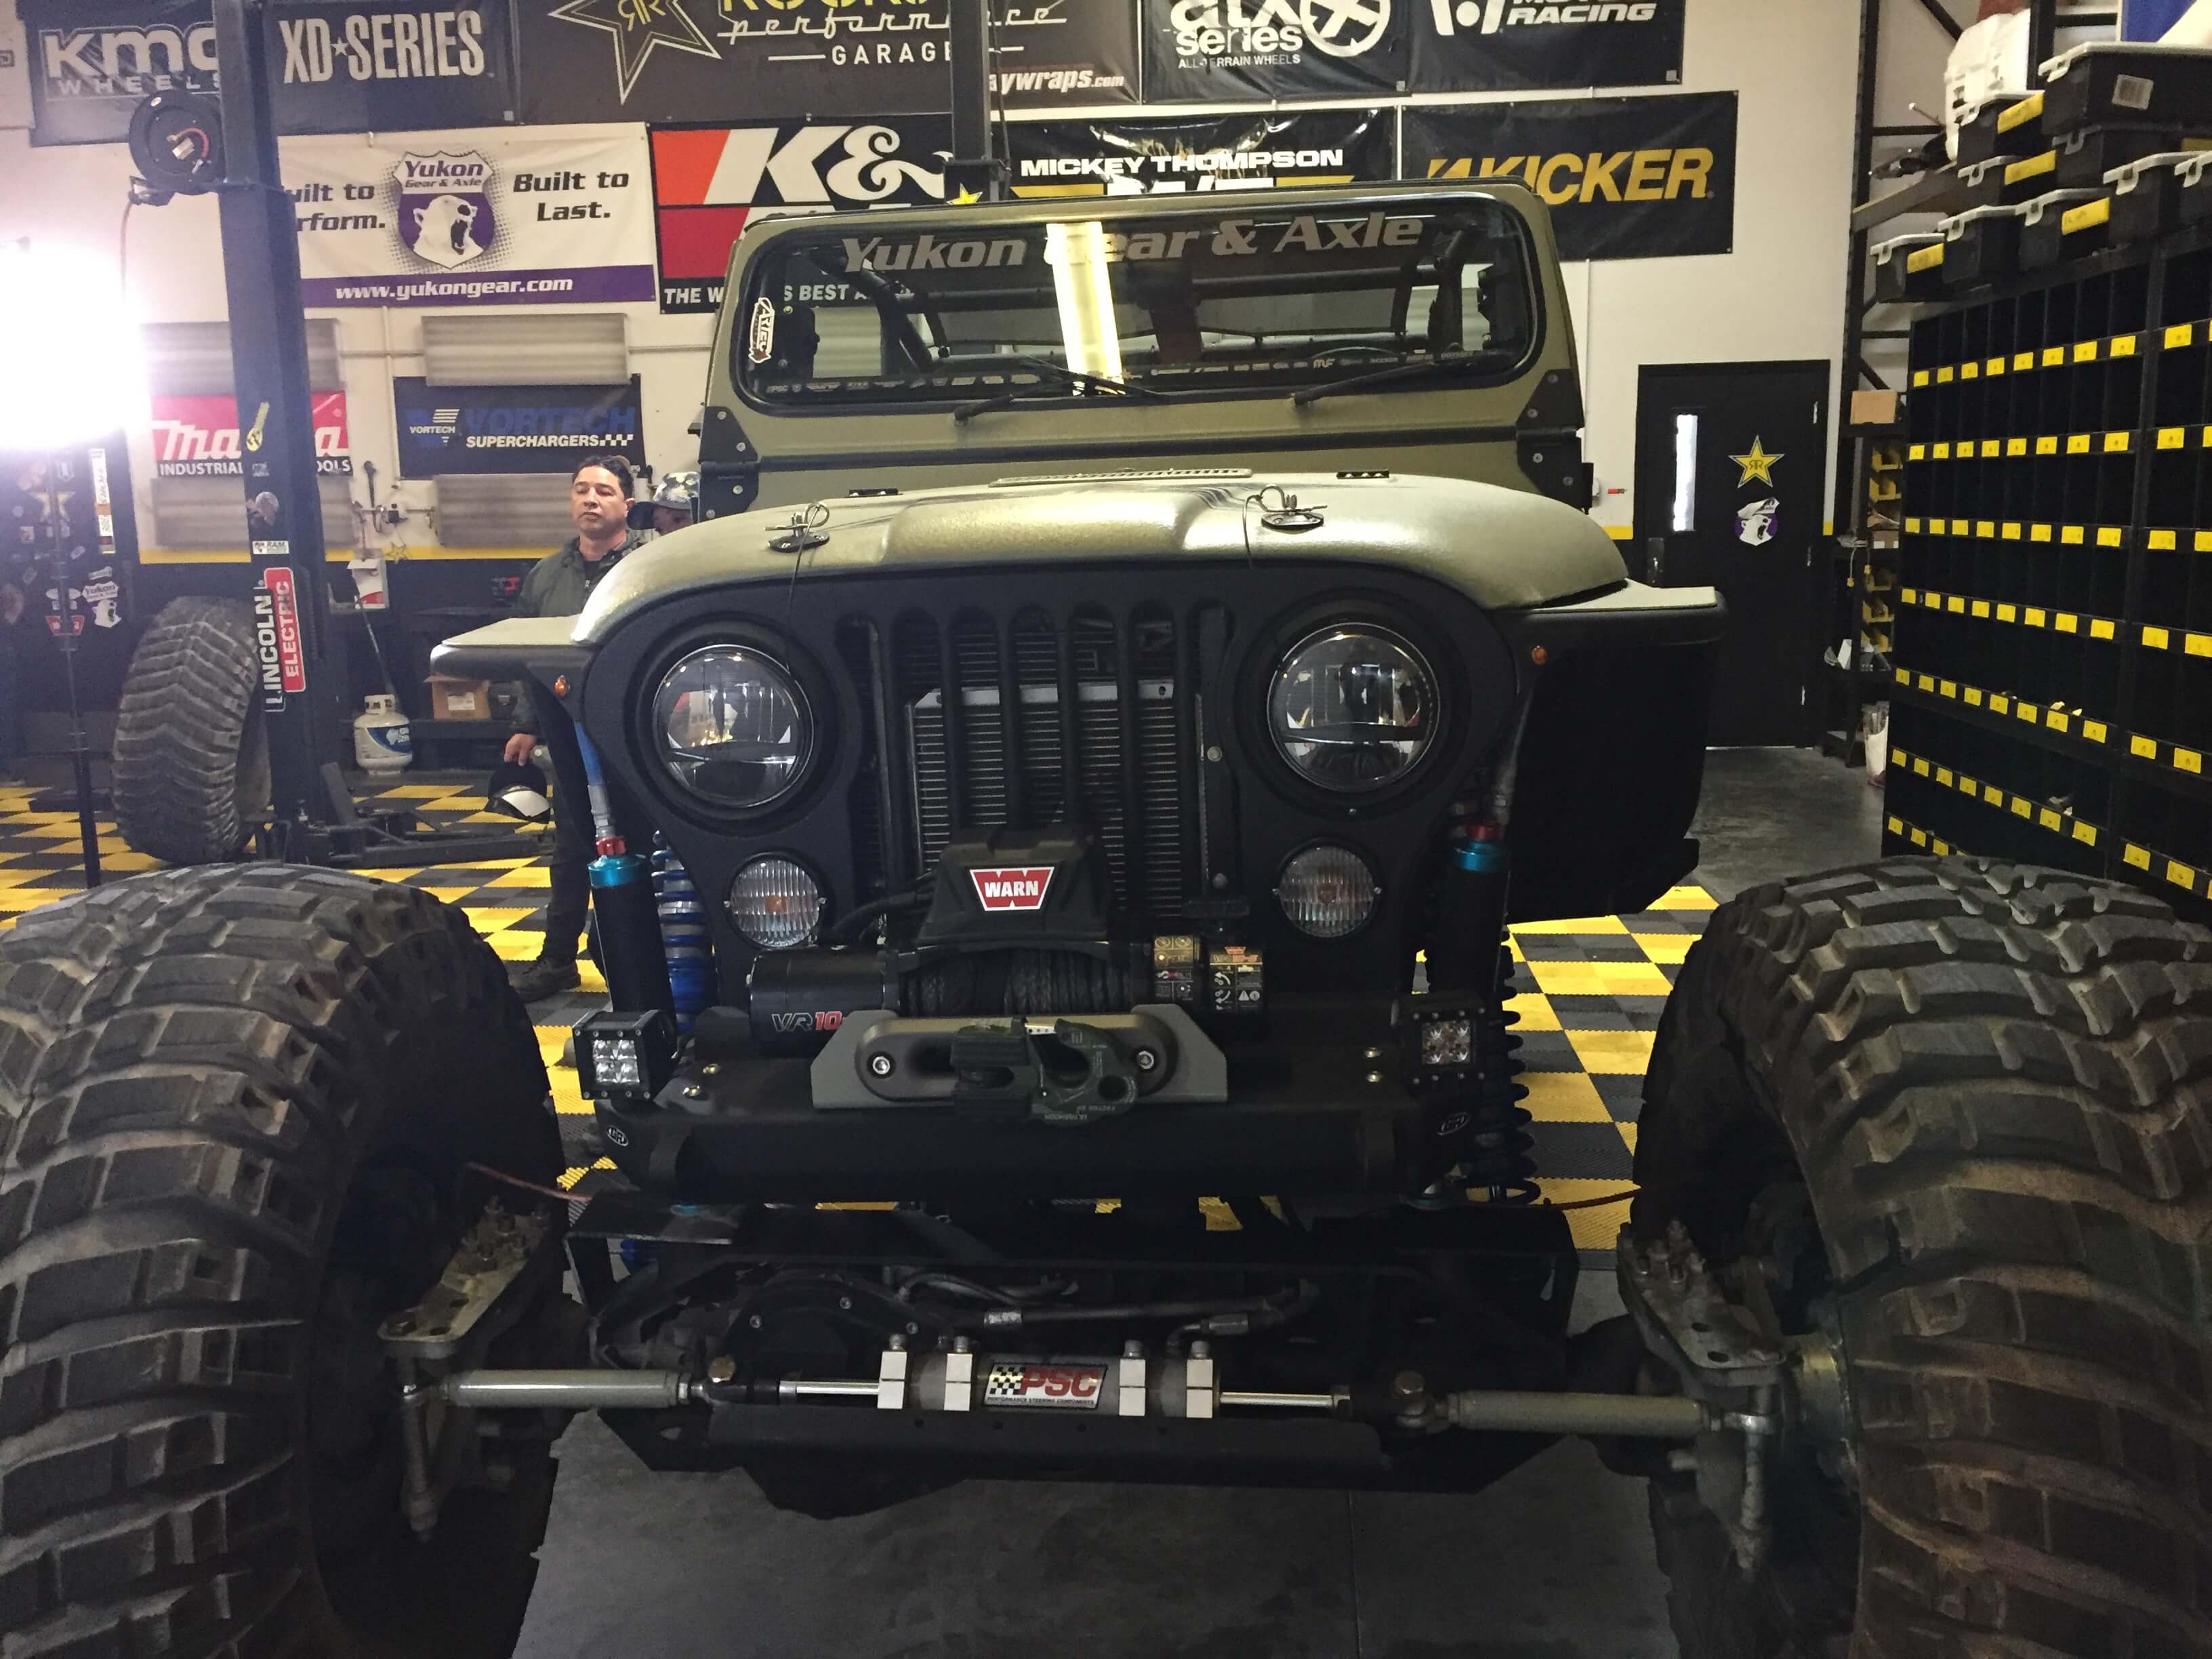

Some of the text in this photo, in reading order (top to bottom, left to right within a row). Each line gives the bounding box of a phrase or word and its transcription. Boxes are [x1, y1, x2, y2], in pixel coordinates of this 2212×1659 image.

[1507, 3, 1656, 25] RACING
[345, 10, 485, 81] SERIES
[1176, 26, 1303, 56] series
[1254, 54, 1301, 65] WHEELS
[405, 160, 483, 177] Yukon
[1021, 149, 1343, 177] MICKEY THOMPSON
[344, 184, 374, 200] to
[513, 171, 630, 192] Built to
[537, 201, 611, 222] Last.
[841, 234, 1027, 272] Yukon
[1211, 219, 1258, 255] &
[1273, 211, 1423, 253] Axle
[335, 279, 573, 300] www.yukongear.com
[663, 287, 701, 304] THE
[799, 284, 849, 301] BEST
[409, 426, 456, 434] VORTECH
[464, 405, 635, 436] VORTECH
[466, 434, 599, 448] SUPERCHARGERS
[276, 580, 300, 678] ELECTRIC
[253, 595, 283, 705] LINCOLN
[984, 880, 1039, 898] WARN
[1019, 1365, 1100, 1397] PSC
